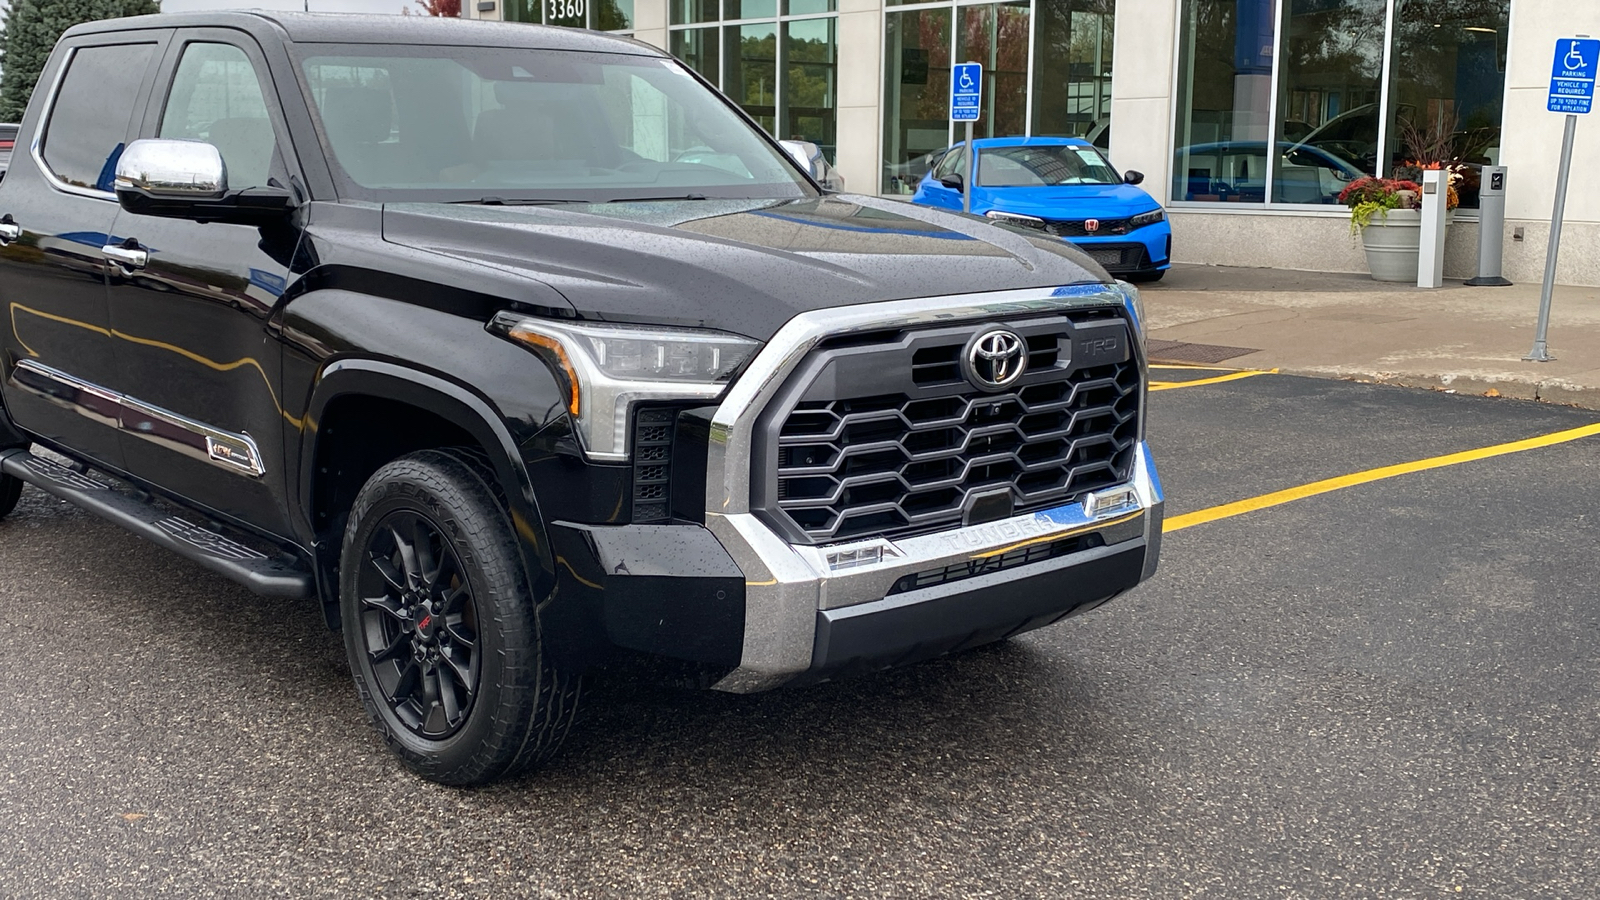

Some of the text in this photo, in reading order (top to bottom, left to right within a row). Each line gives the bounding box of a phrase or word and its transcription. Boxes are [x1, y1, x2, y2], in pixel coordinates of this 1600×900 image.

[549, 0, 584, 19] 3360
[1080, 336, 1117, 356] TRD
[939, 514, 1057, 550] TUNDRA
